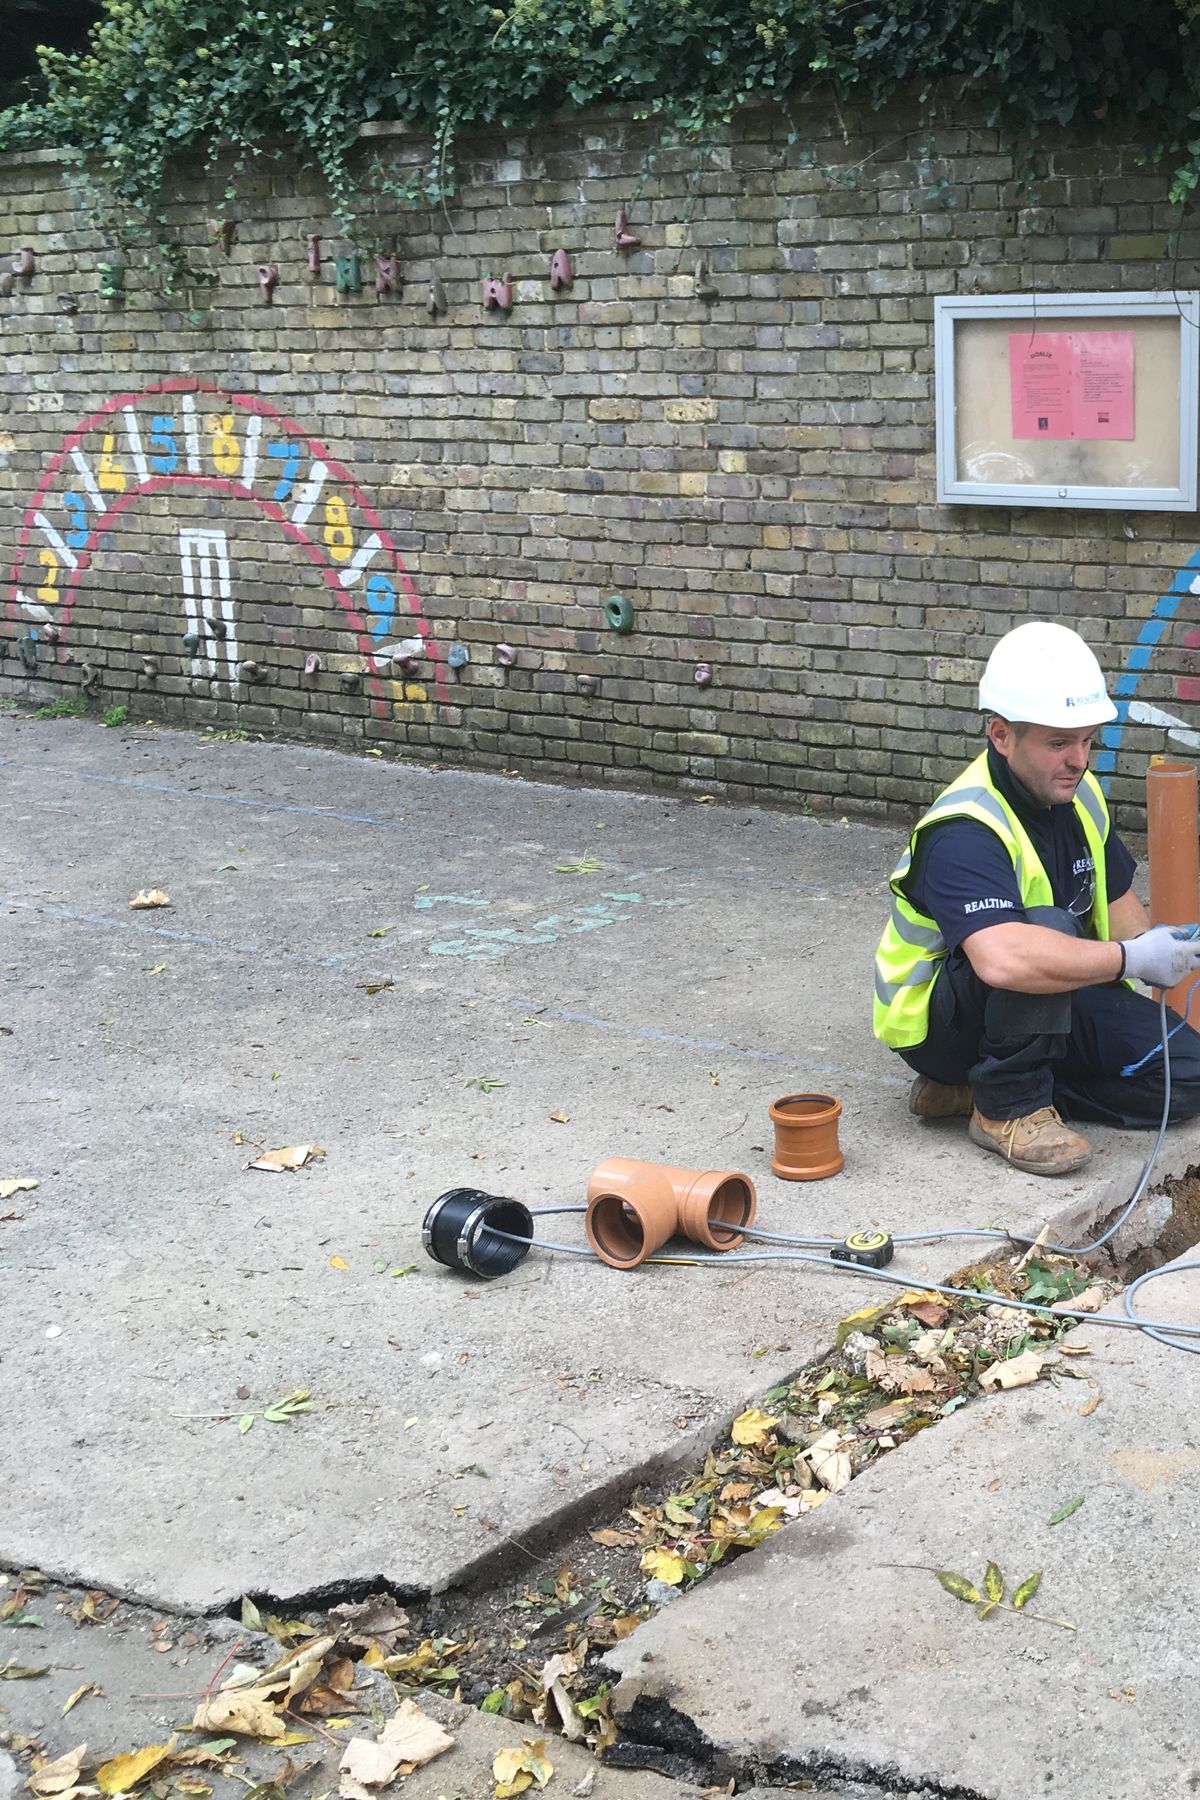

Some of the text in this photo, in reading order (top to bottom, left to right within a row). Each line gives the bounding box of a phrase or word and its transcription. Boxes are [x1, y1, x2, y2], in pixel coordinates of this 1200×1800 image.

[63, 491, 89, 549] 3
[150, 416, 178, 474] 5
[267, 442, 299, 500] 7
[323, 496, 353, 561] 8
[367, 574, 396, 642] 9
